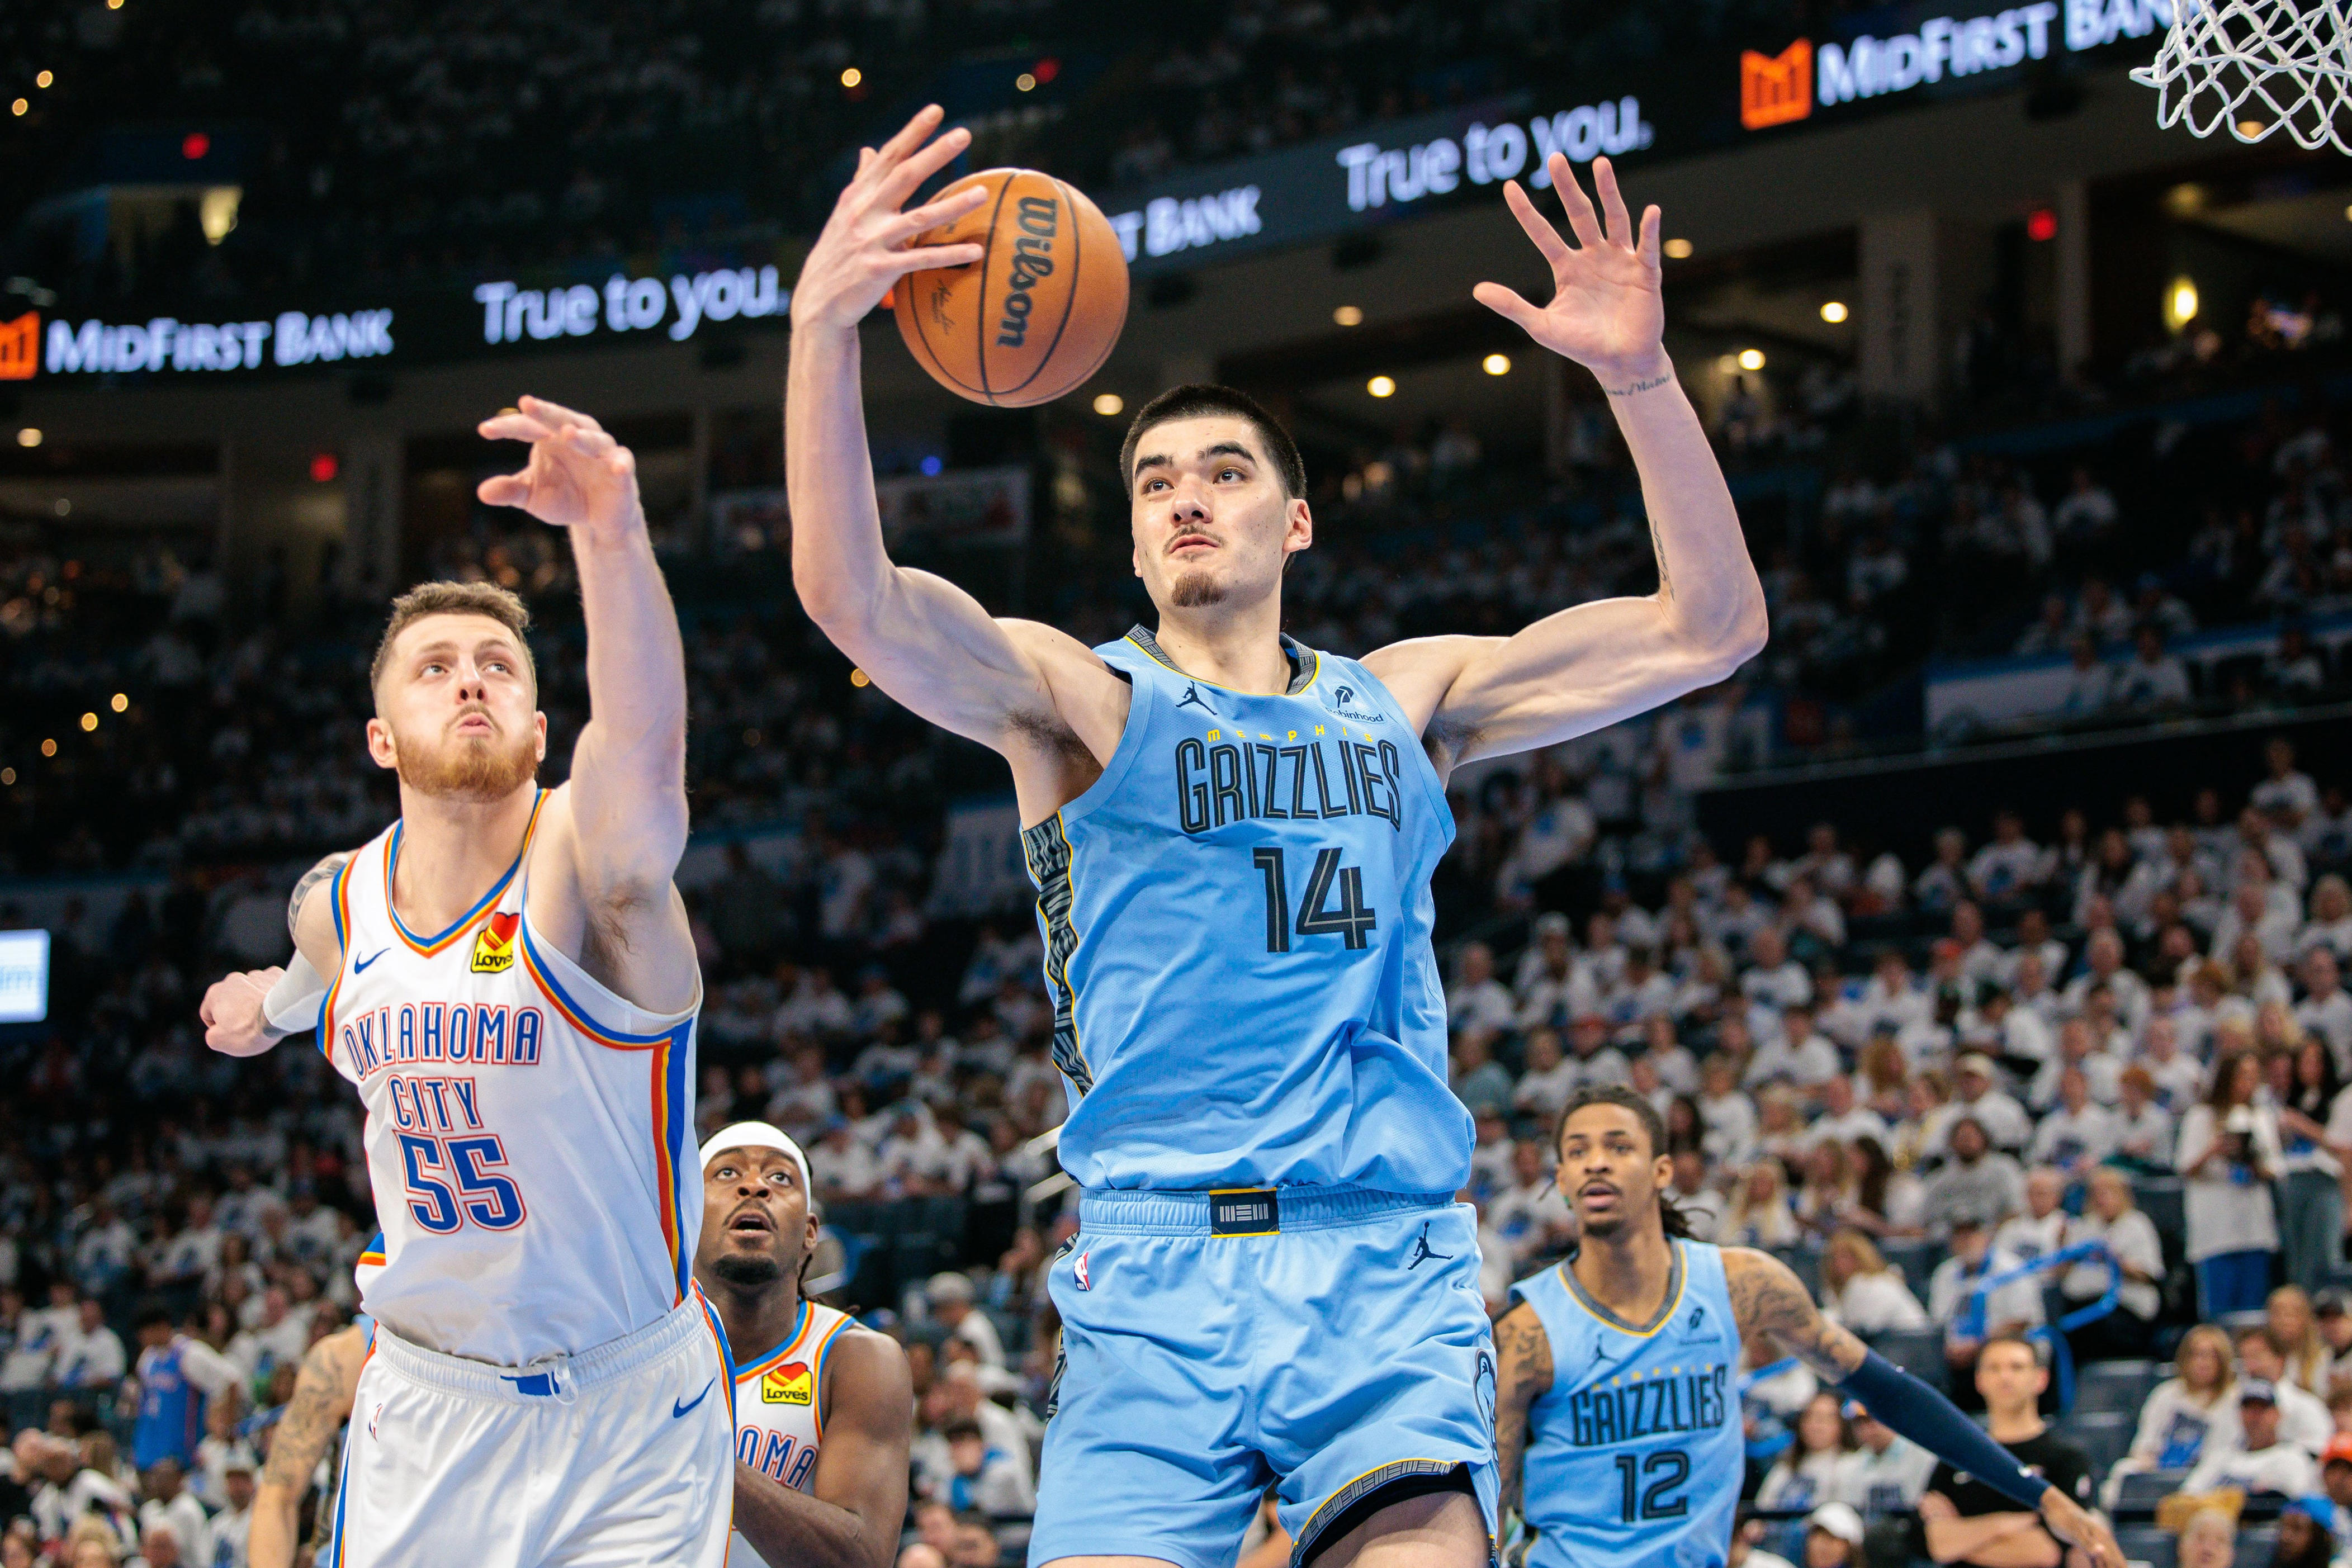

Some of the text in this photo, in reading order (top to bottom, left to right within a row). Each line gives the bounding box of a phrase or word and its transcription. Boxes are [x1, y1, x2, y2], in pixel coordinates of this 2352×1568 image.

[1336, 94, 1655, 211] True to you.
[1146, 184, 1262, 257] BANK
[473, 264, 792, 344] True to you.
[995, 196, 1058, 348] Wilson
[1208, 724, 1373, 742] MEMPHIS
[1175, 736, 1402, 835] GRIZZLIES
[1252, 847, 1376, 954] 14
[342, 1001, 543, 1081] OKLAHOMA
[386, 1074, 484, 1133] CITY
[391, 1129, 527, 1235] 55
[1569, 1363, 1729, 1447] GRIZZLIES
[1615, 1449, 1690, 1523] 12
